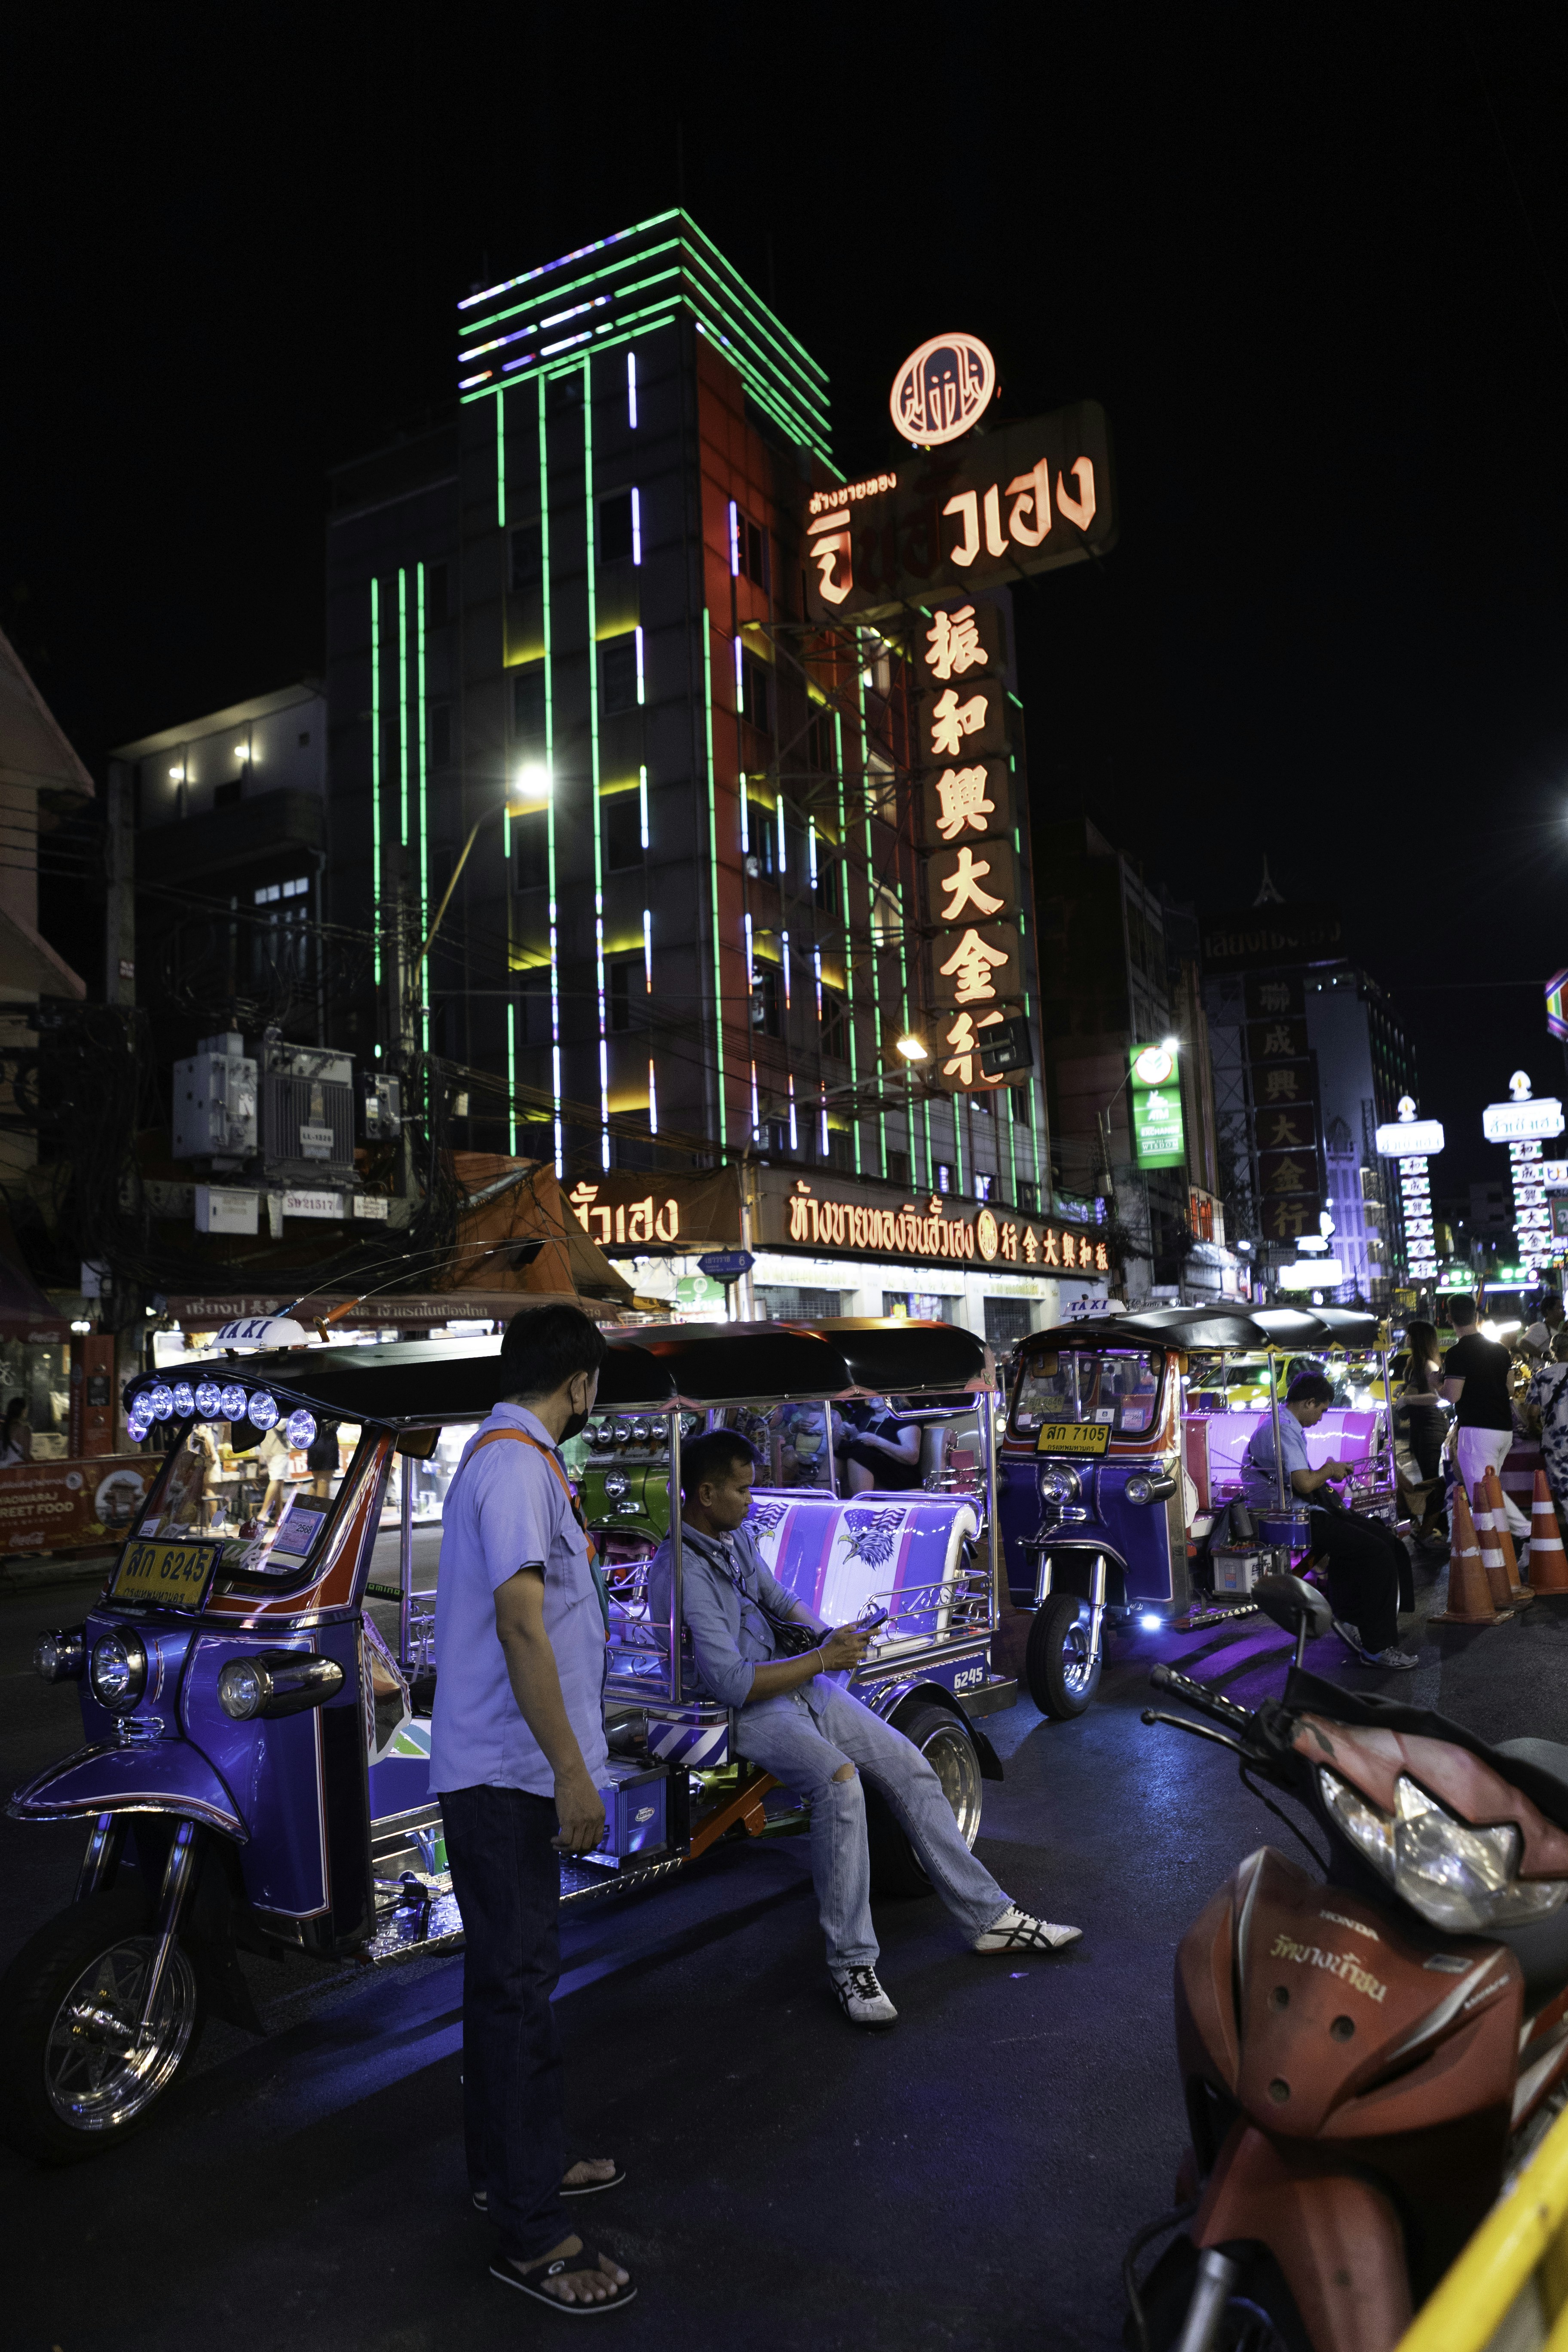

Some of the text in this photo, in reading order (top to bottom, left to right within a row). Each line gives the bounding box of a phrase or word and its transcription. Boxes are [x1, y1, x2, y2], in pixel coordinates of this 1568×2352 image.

[809, 473, 897, 514] ห้างขายทอง
[1148, 1108, 1169, 1121] ATM
[1141, 1125, 1180, 1137] EXCHANGE
[1142, 1142, 1179, 1150] WISDOM
[789, 1180, 974, 1260] ห้างขายทองจินฮั้วเฮง
[739, 1256, 745, 1266] 6
[1070, 1299, 1108, 1311] TAXI
[218, 1320, 274, 1339] TAXI
[1047, 1425, 1106, 1441] สก 7105
[1047, 1444, 1095, 1452] กรงเทพมหานคร
[0, 1501, 74, 1518] REET FOOD
[296, 1524, 313, 1534] 2568
[161, 1550, 210, 1582] 6245
[124, 1588, 185, 1603] กรงเทพมหานคร
[954, 1666, 983, 1689] 6245
[1320, 1909, 1380, 1942] HONDA
